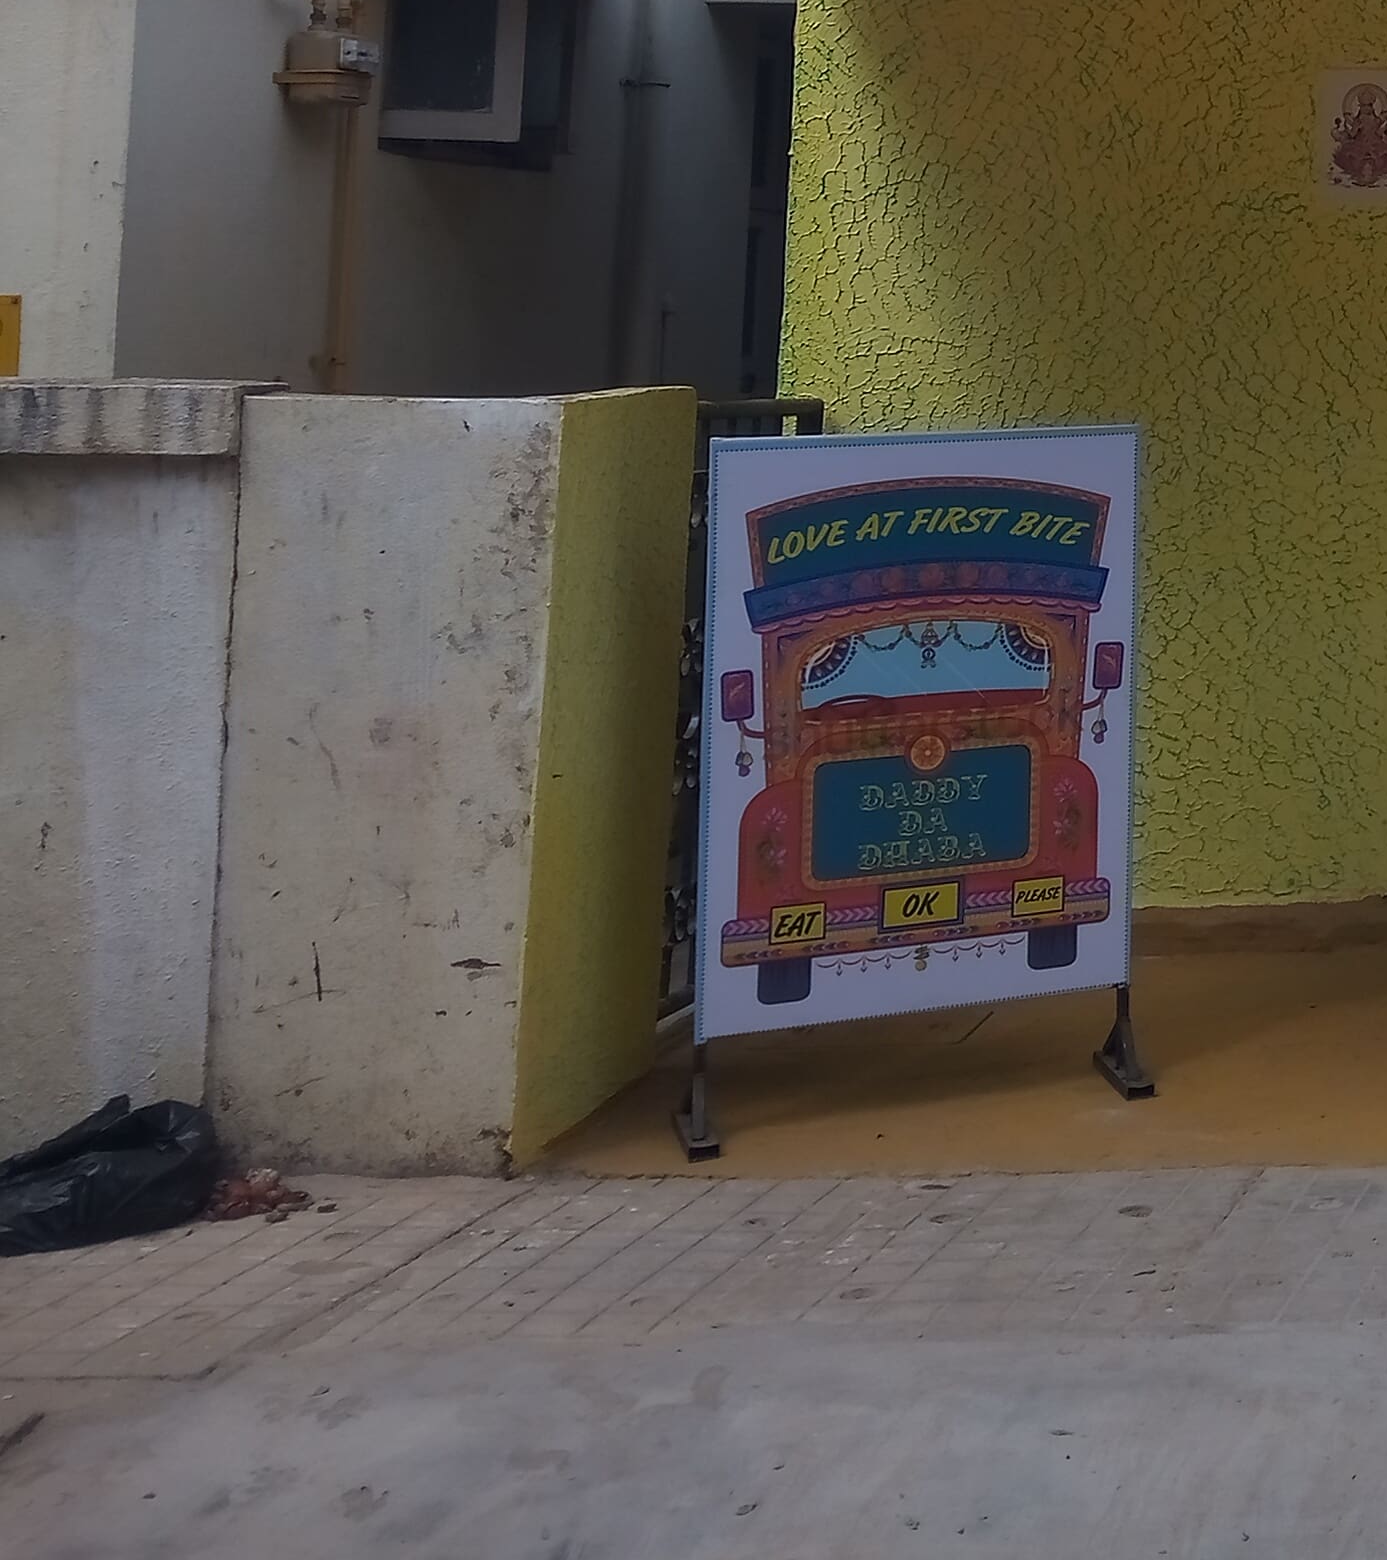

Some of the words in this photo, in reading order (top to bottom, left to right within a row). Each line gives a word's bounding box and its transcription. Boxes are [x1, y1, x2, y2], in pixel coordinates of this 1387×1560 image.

[767, 519, 849, 565] LOVE
[855, 511, 904, 542] AT
[907, 506, 1009, 536] FIRST
[1009, 511, 1091, 545] BITE
[859, 774, 988, 811] DADDY
[898, 807, 948, 836] DA
[857, 832, 987, 870] DHABA
[902, 891, 940, 918] OK
[1015, 886, 1061, 905] PLEASE
[774, 911, 821, 938] EAT
